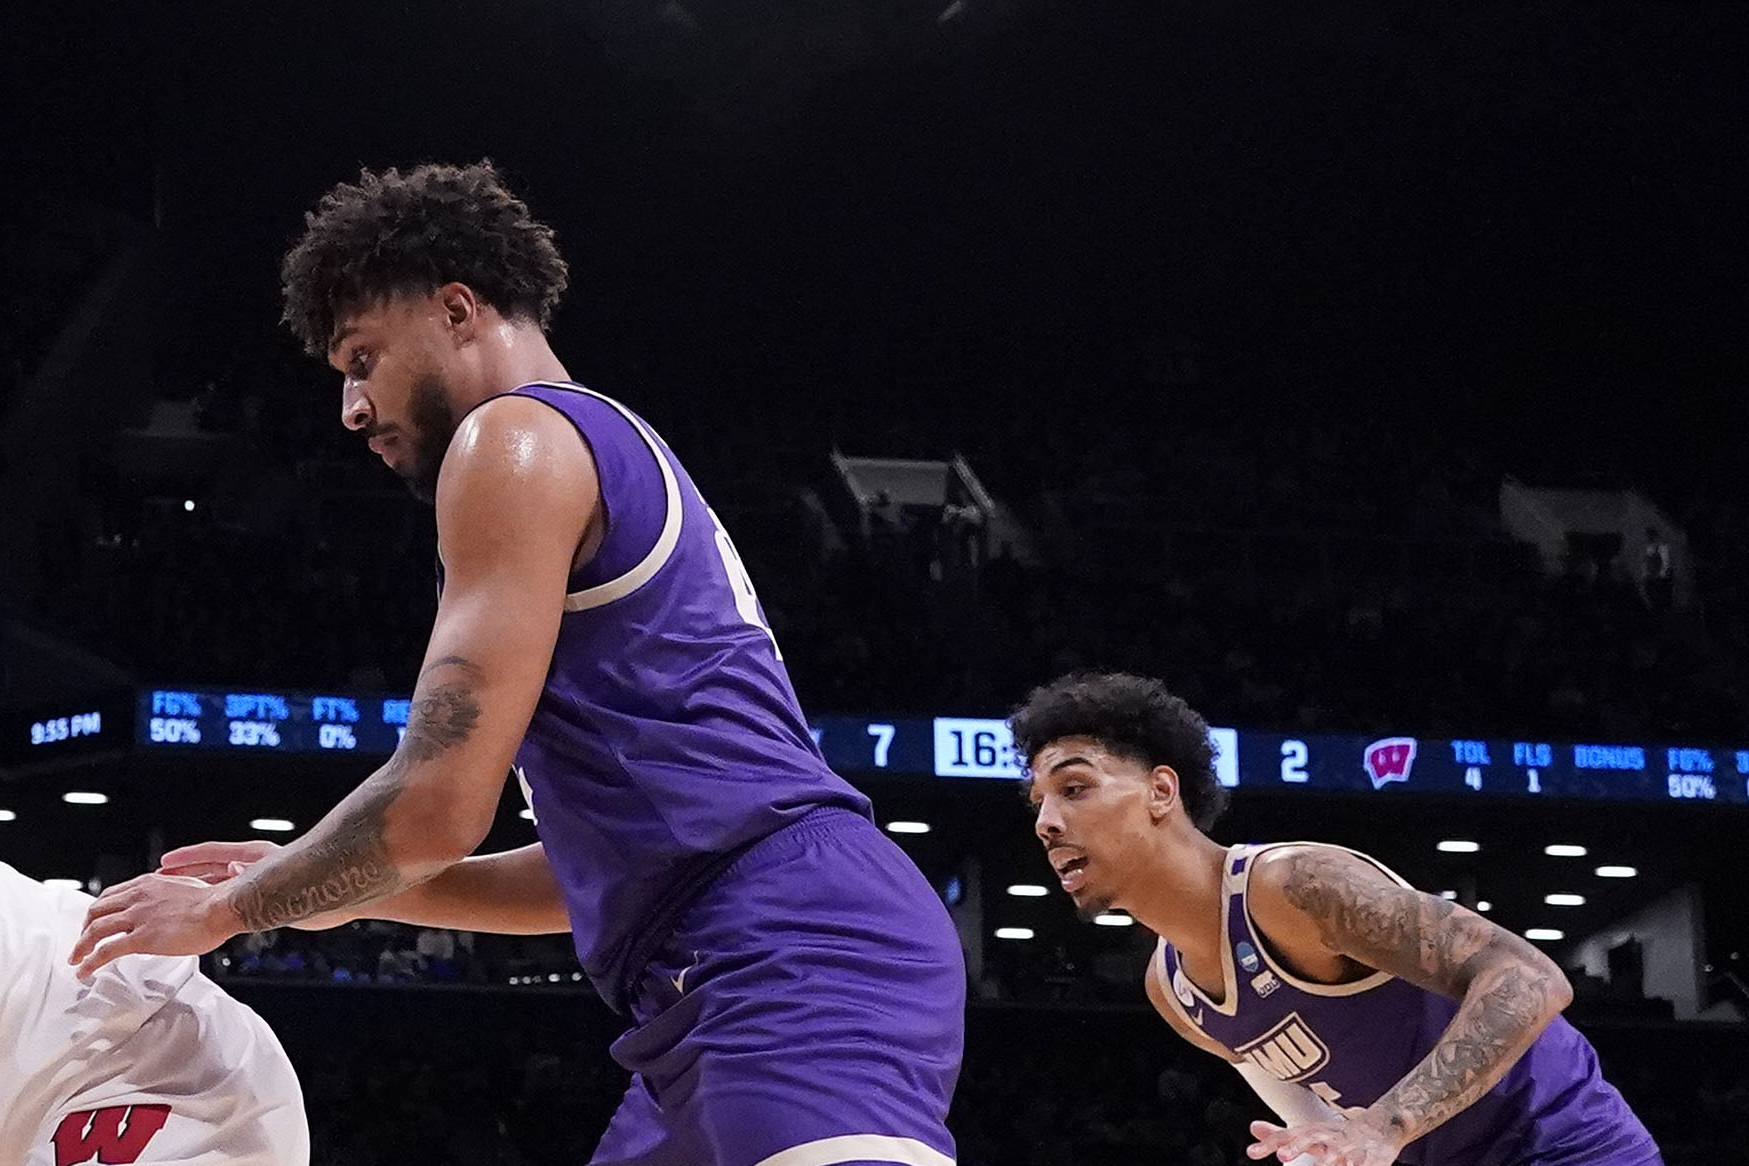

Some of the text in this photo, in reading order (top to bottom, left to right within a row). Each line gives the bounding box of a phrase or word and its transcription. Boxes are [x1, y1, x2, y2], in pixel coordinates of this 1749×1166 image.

[151, 690, 202, 717] FG%
[311, 696, 360, 722] FT%
[71, 711, 101, 738] PM
[150, 717, 358, 750] 50% 33% 0%
[866, 723, 896, 768] 7
[1280, 739, 1310, 783] 2
[1525, 768, 1542, 793] 1
